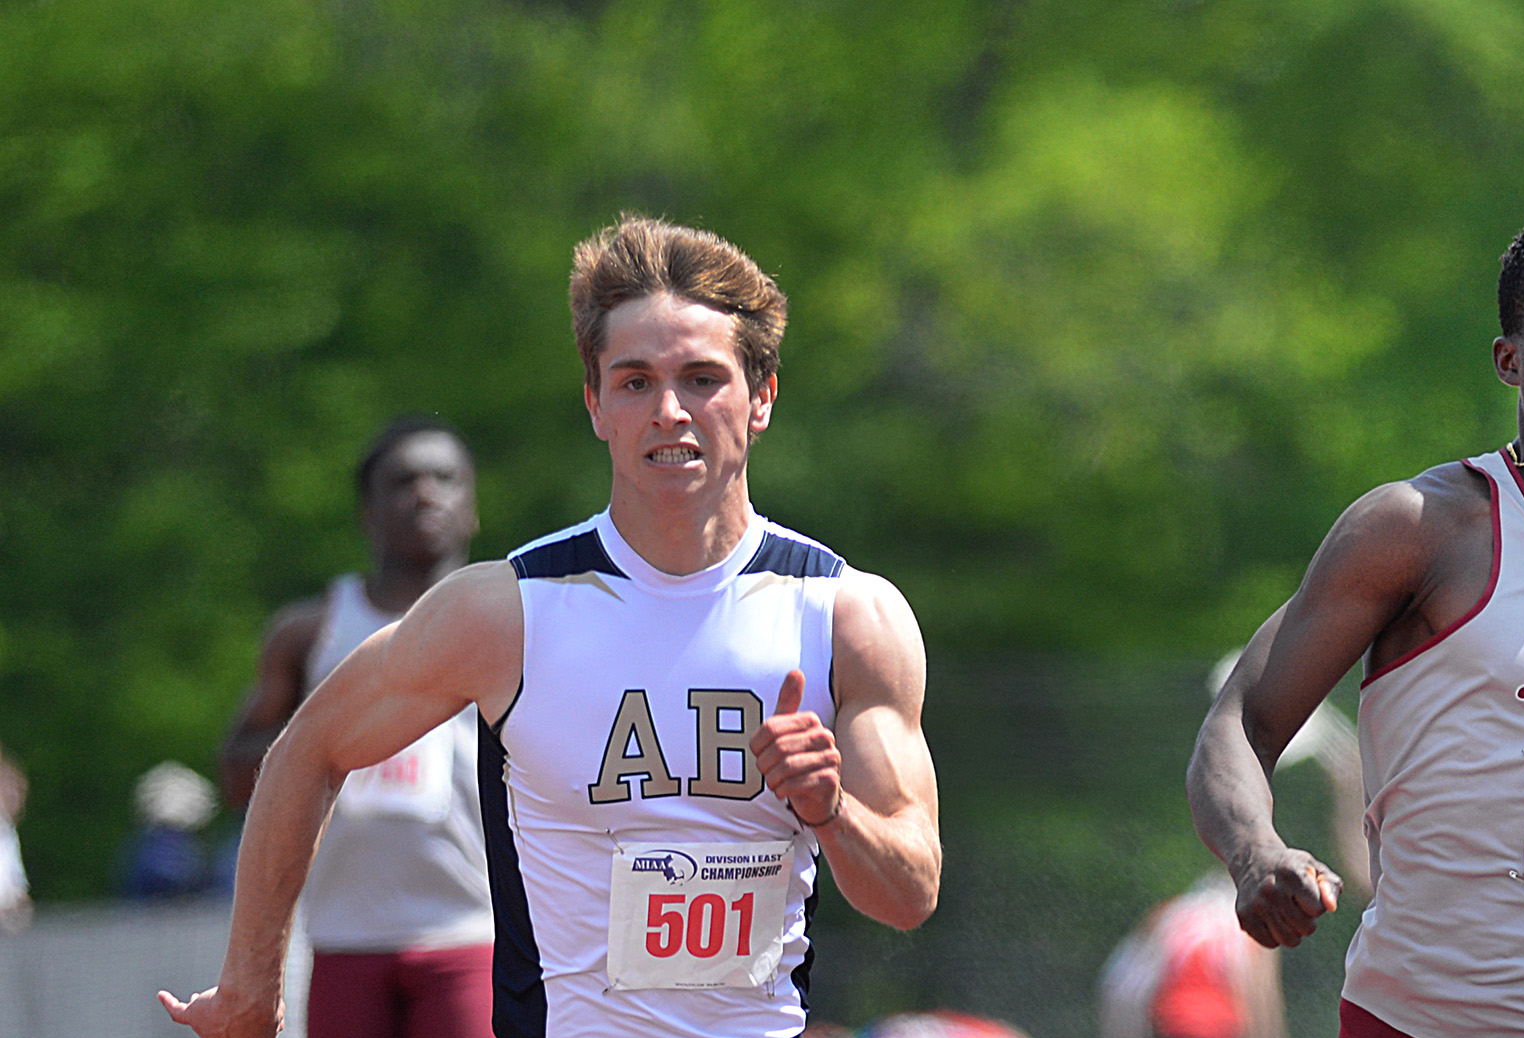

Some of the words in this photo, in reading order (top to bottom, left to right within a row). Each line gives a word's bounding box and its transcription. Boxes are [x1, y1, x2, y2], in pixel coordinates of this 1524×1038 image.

[588, 688, 765, 804] AB
[634, 859, 668, 870] MIAA
[705, 855, 750, 864] DIVISION
[758, 854, 783, 863] EAST
[701, 864, 783, 881] CHAMPIONSHIP
[645, 892, 755, 958] 501
